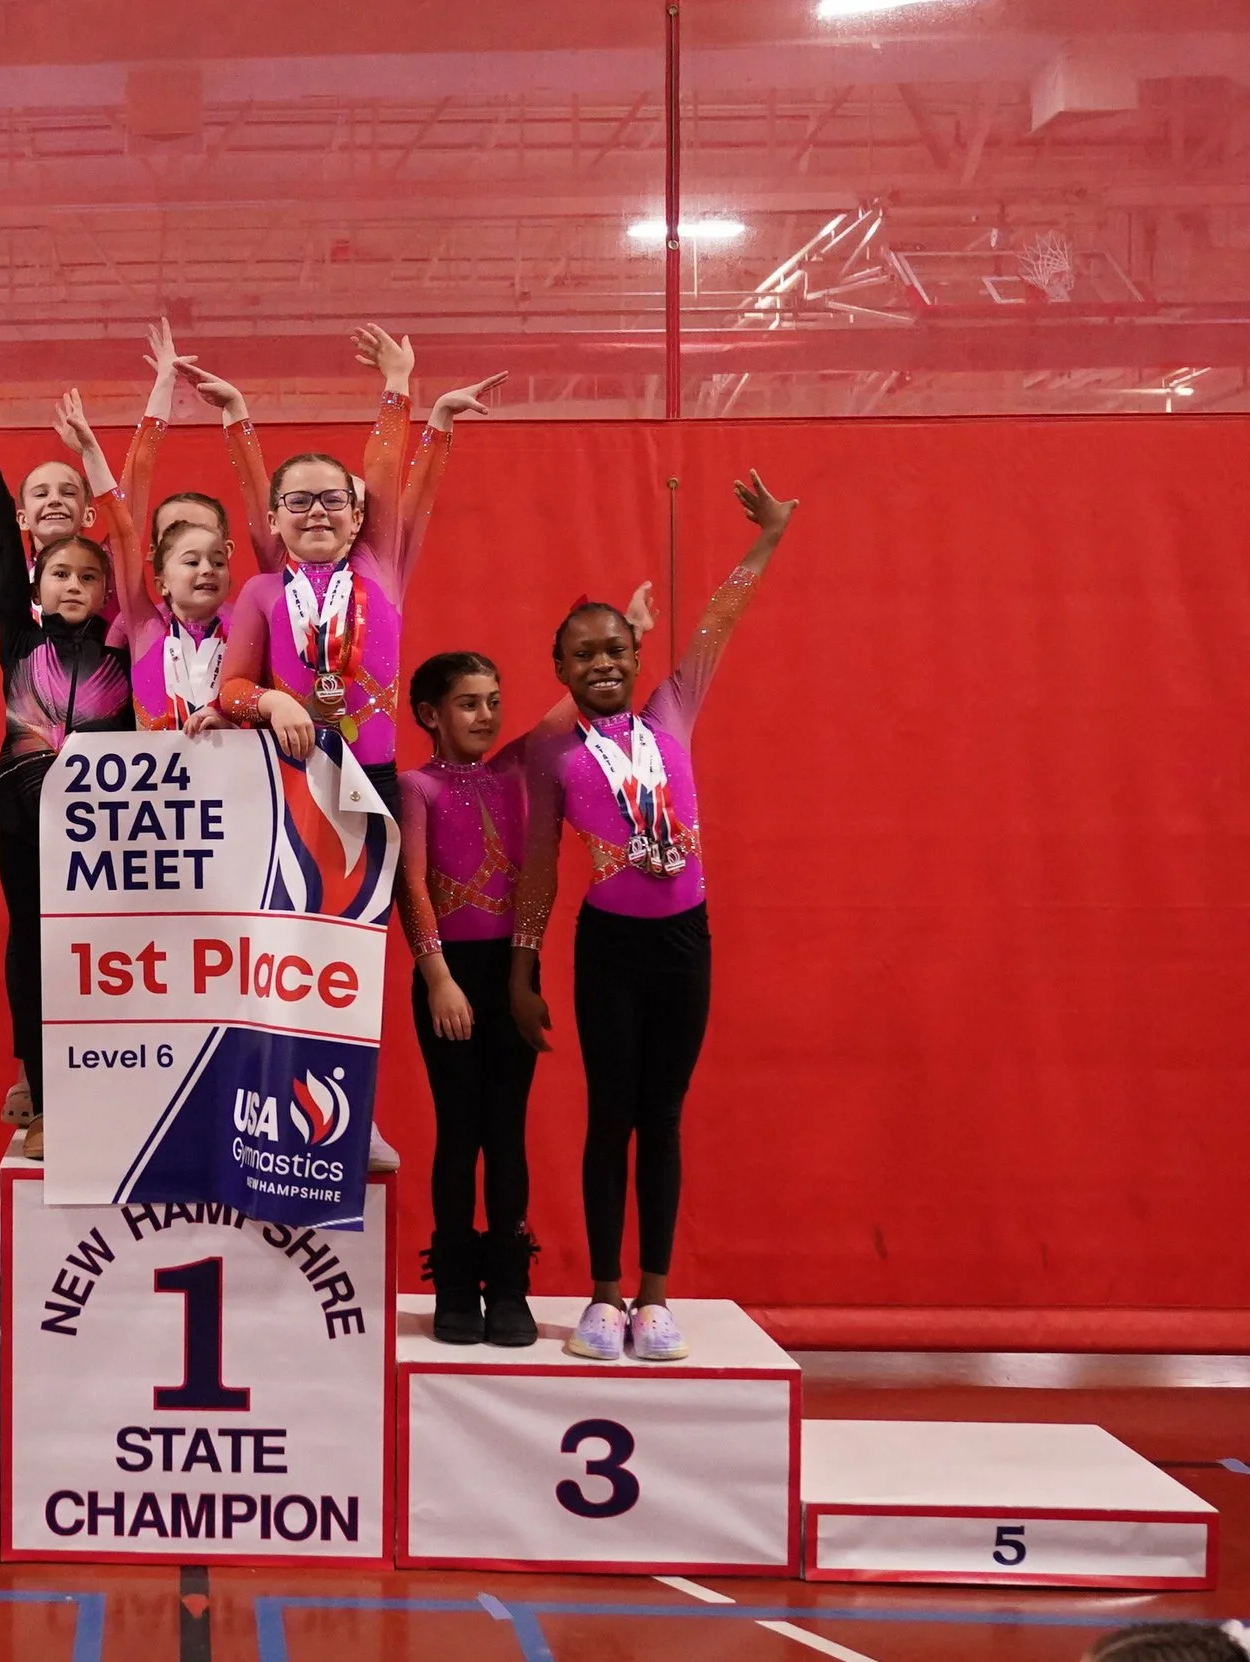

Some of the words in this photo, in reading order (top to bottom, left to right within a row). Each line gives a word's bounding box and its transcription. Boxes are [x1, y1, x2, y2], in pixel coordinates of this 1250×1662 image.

[210, 654, 223, 689] STATE
[65, 753, 190, 792] 2024
[66, 800, 224, 842] STATE
[67, 850, 213, 891] MEET
[70, 941, 167, 996] 1st
[193, 936, 359, 1008] Place
[69, 1045, 145, 1069] Level
[157, 1044, 174, 1068] 6
[233, 1088, 278, 1142] USA
[232, 1137, 344, 1182] Gymnastics
[259, 1180, 341, 1202] HAMPSHIRE
[41, 1227, 116, 1336] NEW
[154, 1257, 251, 1412] 1
[116, 1426, 288, 1474] STATE
[556, 1419, 640, 1518] 3
[45, 1490, 359, 1542] CHAMPION
[992, 1525, 1027, 1566] 5
